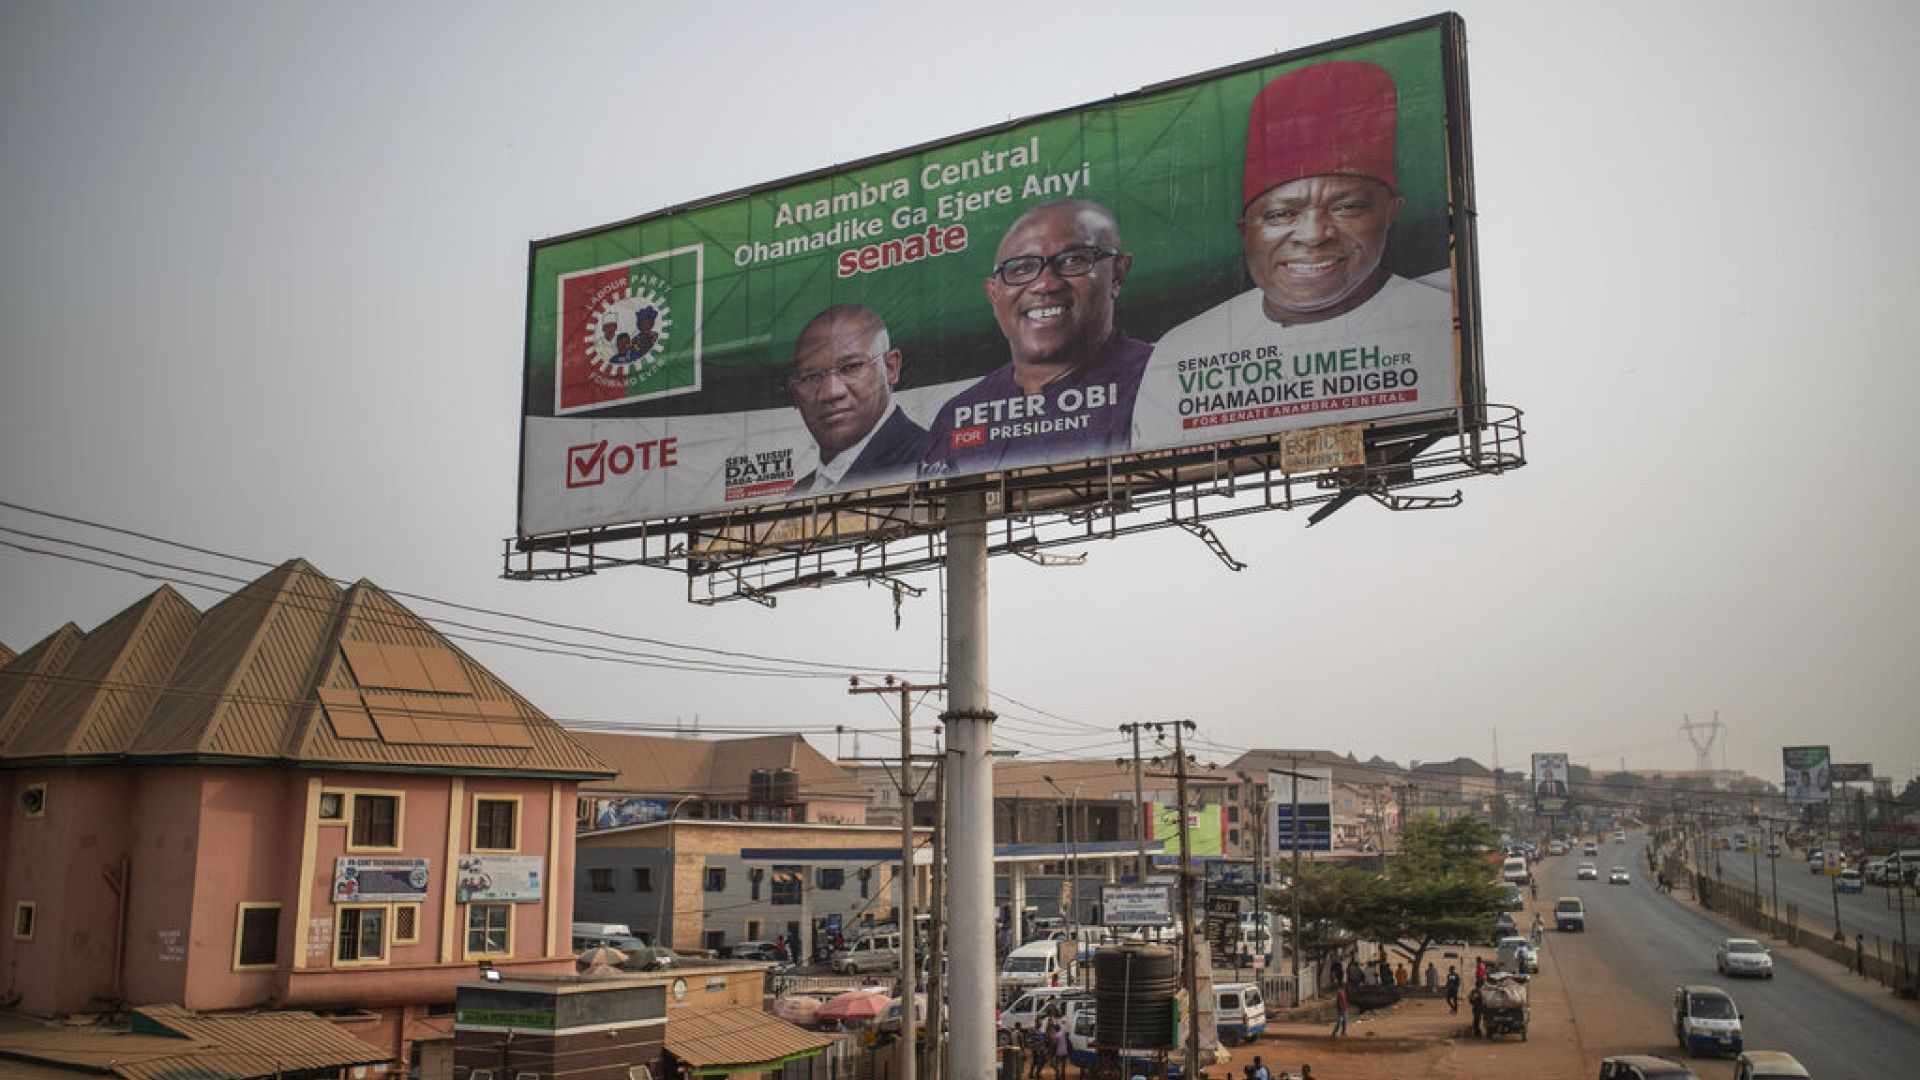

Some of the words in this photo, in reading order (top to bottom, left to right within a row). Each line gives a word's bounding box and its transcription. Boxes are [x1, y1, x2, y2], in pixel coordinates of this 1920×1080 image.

[775, 177, 910, 229] Anambra
[921, 136, 1039, 190] Central
[734, 217, 884, 267] Ohamadike
[891, 204, 928, 229] Ga
[938, 185, 1012, 222] Ejere
[1021, 162, 1091, 199] Anyi
[838, 223, 968, 278] senate
[1177, 349, 1251, 373] SENATOR
[1179, 359, 1284, 394] VICTOR
[1293, 345, 1380, 377] UMEH
[954, 394, 1046, 429] PETER
[1057, 383, 1118, 413] OBI
[1178, 379, 1315, 416] OHAMADIKE
[1322, 368, 1419, 399] NDIGBO
[1192, 417, 1218, 428] FOR
[1222, 408, 1269, 424] SENATE
[1272, 400, 1339, 418] ANAMBRA
[1342, 392, 1406, 410] CENTRAL
[955, 429, 981, 444] FOR
[989, 414, 1091, 441] PRESIDENT
[725, 457, 792, 479] DATTI
